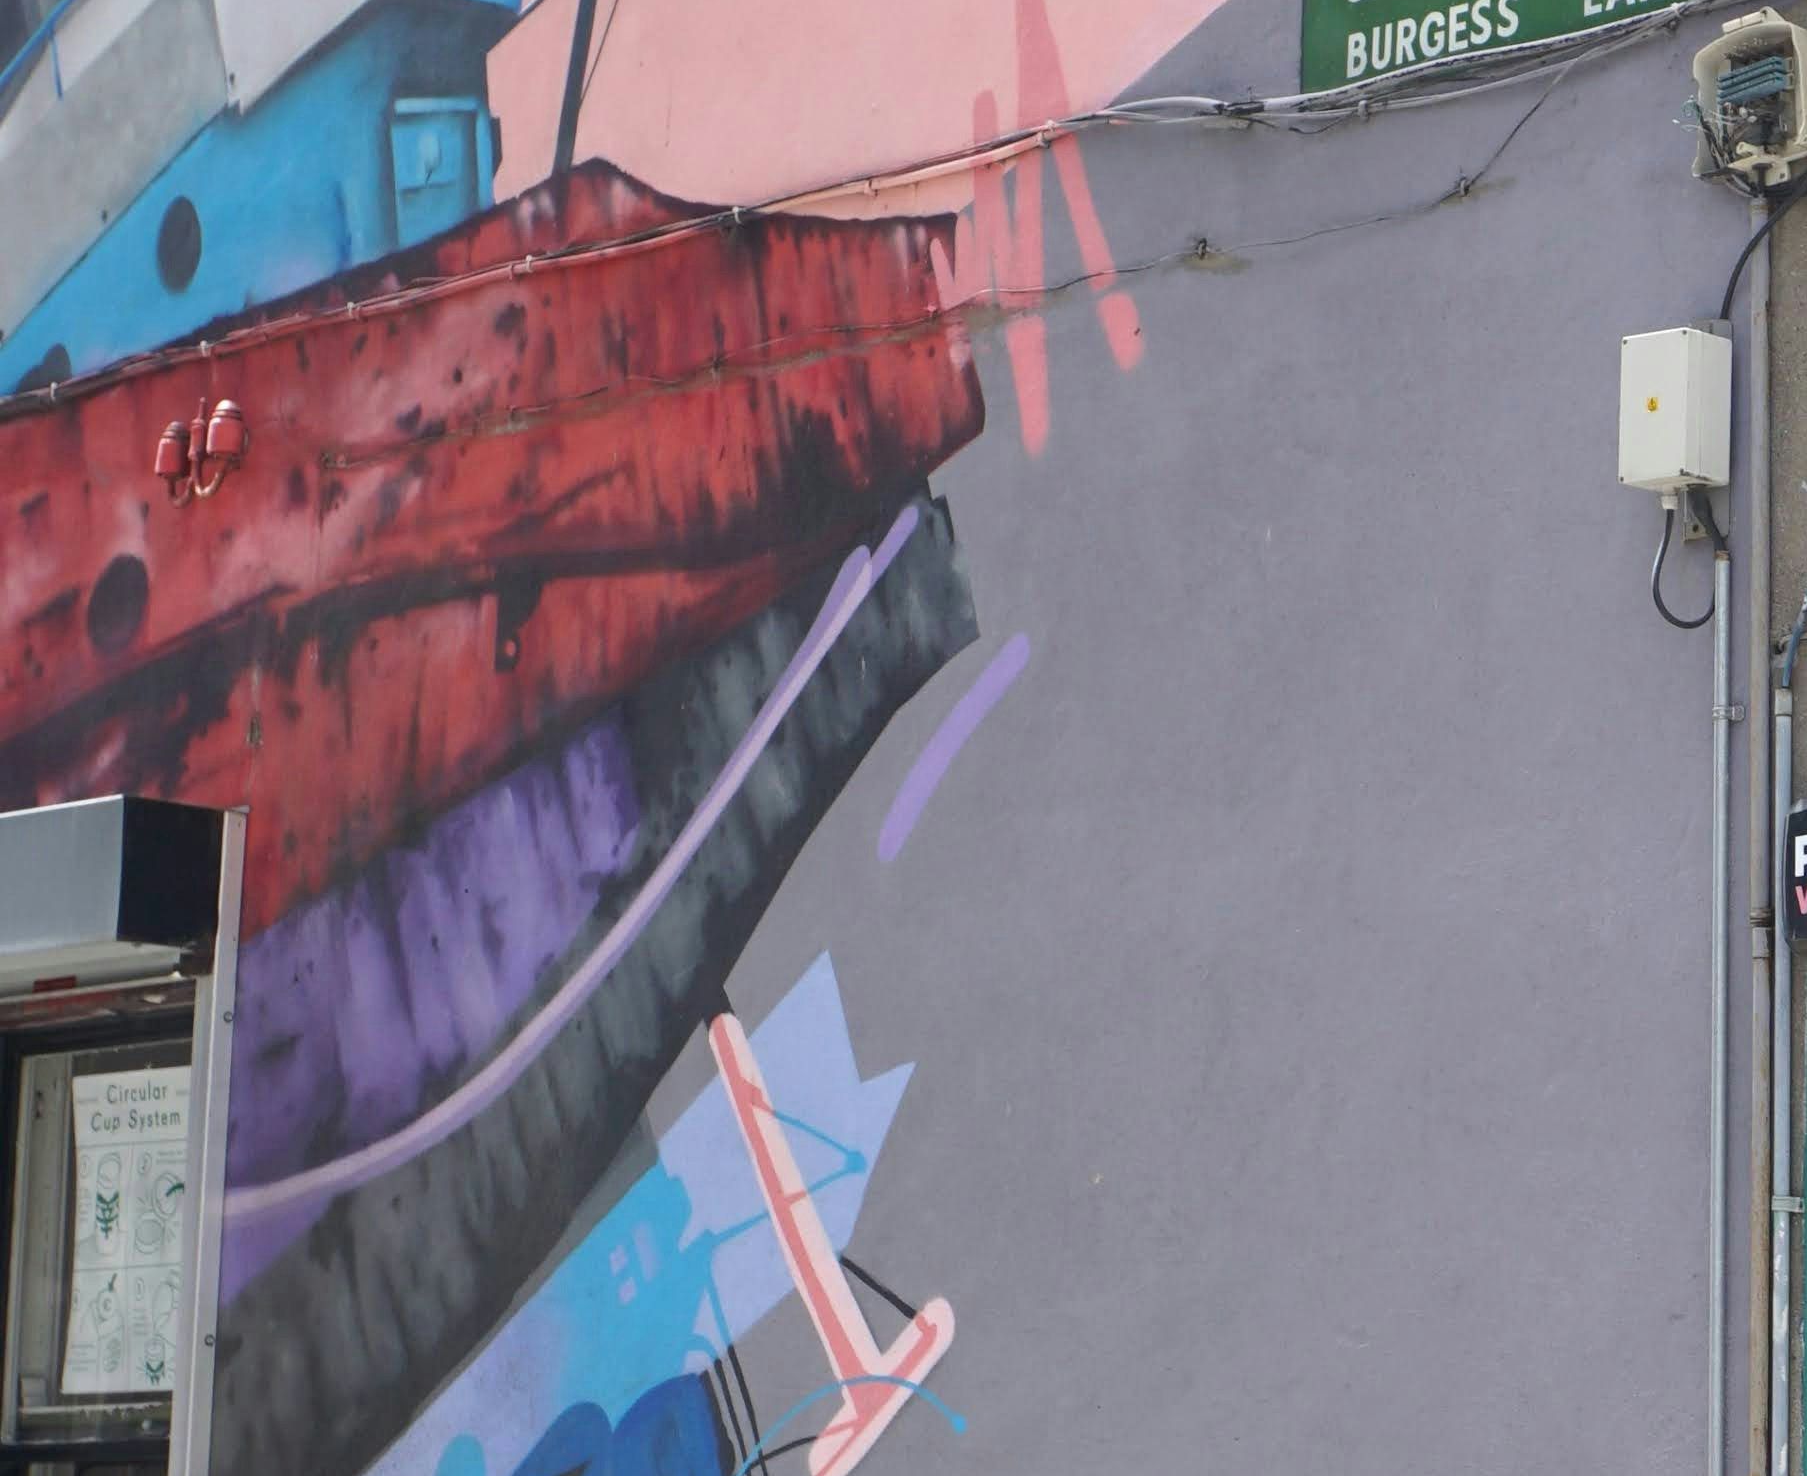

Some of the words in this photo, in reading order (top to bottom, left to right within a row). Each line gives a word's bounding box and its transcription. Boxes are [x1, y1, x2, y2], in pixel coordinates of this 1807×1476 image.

[106, 1080, 167, 1104] Circular
[91, 1112, 120, 1133] Cup
[128, 1108, 180, 1132] System
